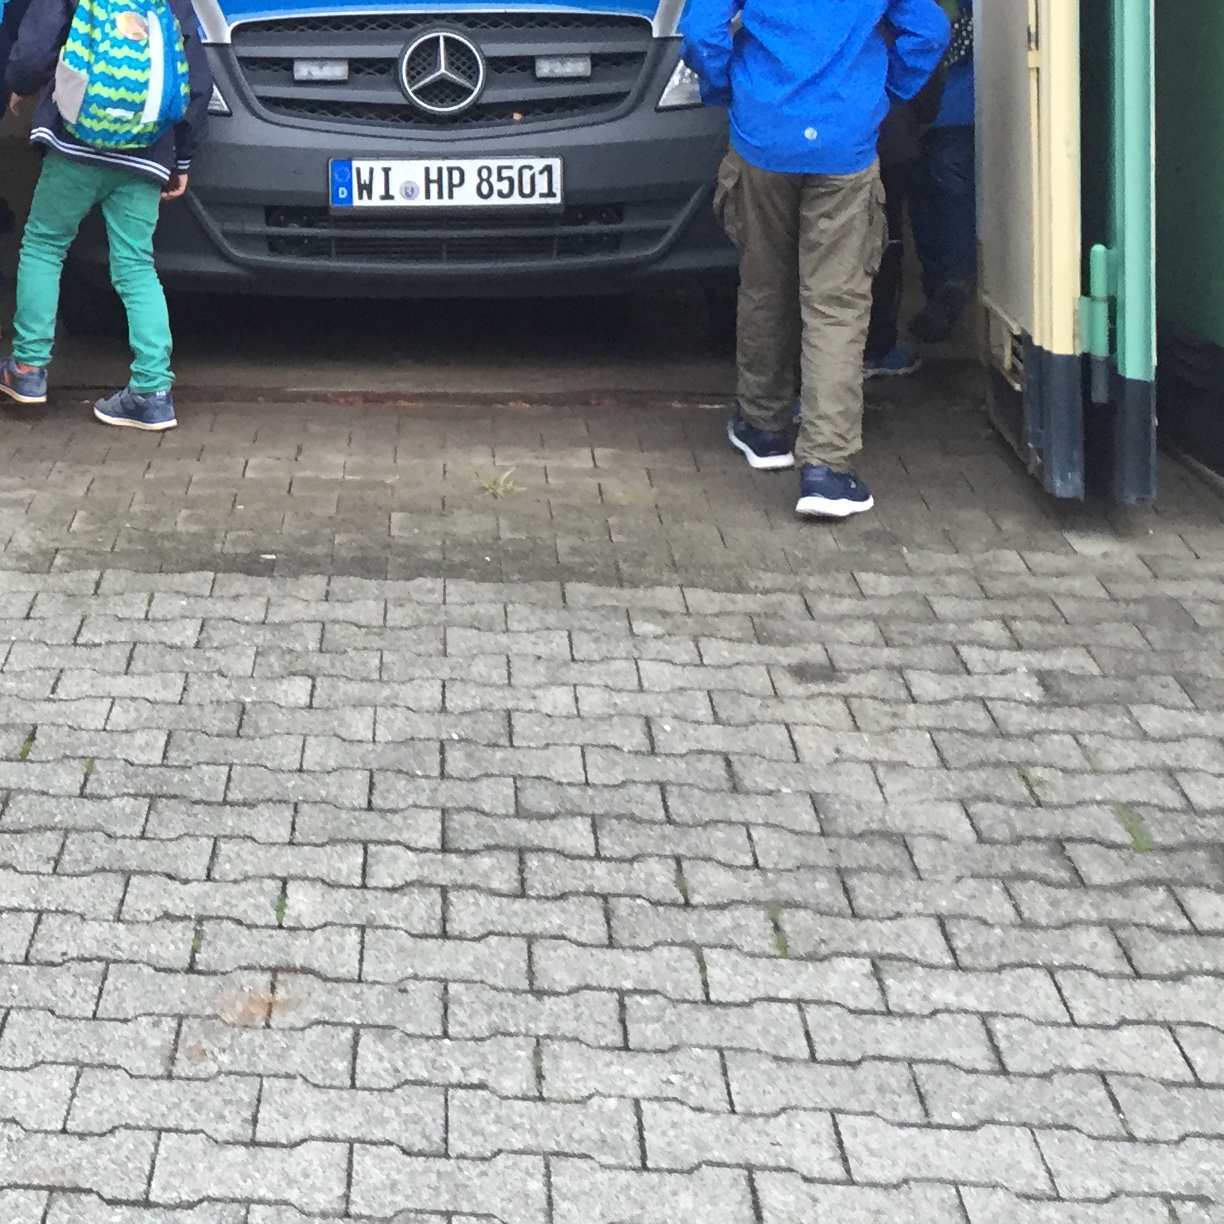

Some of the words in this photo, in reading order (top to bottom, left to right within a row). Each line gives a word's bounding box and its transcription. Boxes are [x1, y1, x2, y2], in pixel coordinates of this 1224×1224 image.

[355, 166, 395, 201] WI
[424, 166, 466, 200] HP
[475, 164, 557, 200] 8501
